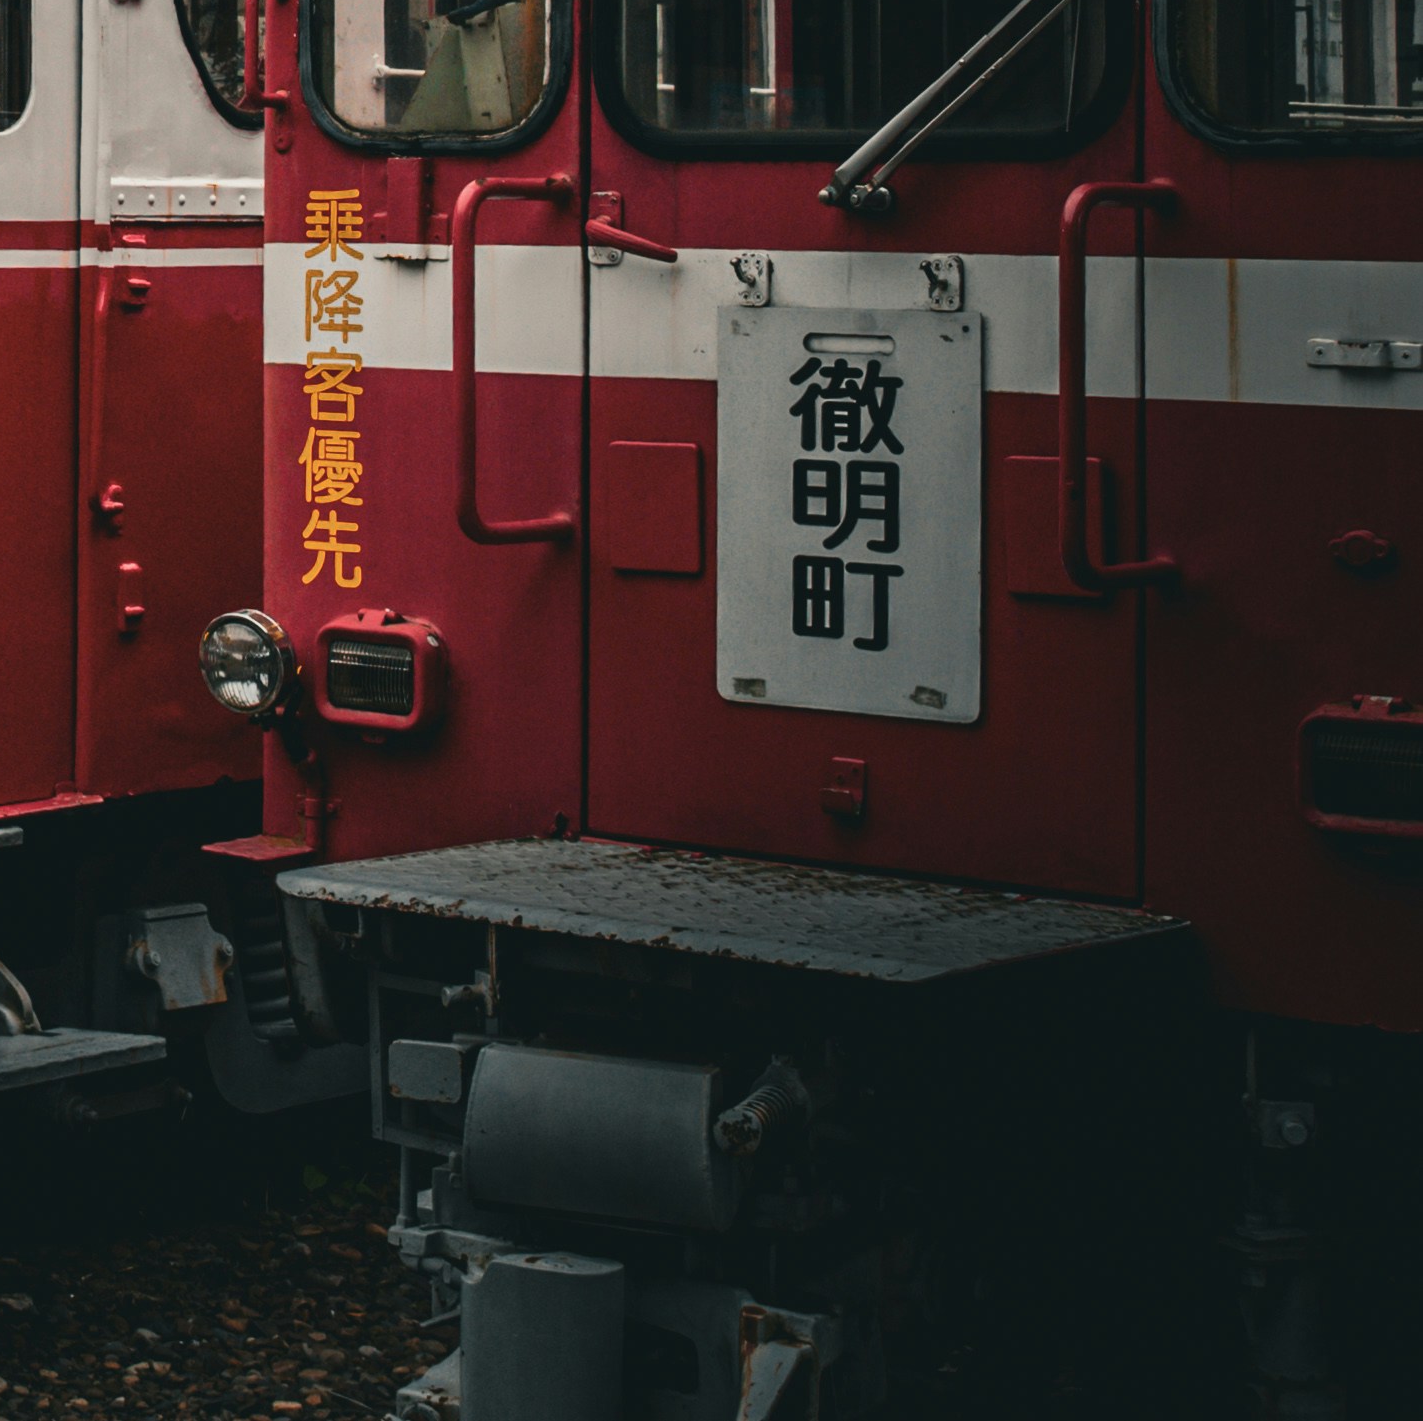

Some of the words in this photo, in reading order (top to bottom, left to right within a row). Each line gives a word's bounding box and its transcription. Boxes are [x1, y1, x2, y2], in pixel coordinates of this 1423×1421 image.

[297, 187, 365, 589] 乗降客優先
[787, 356, 905, 651] 徹明町
